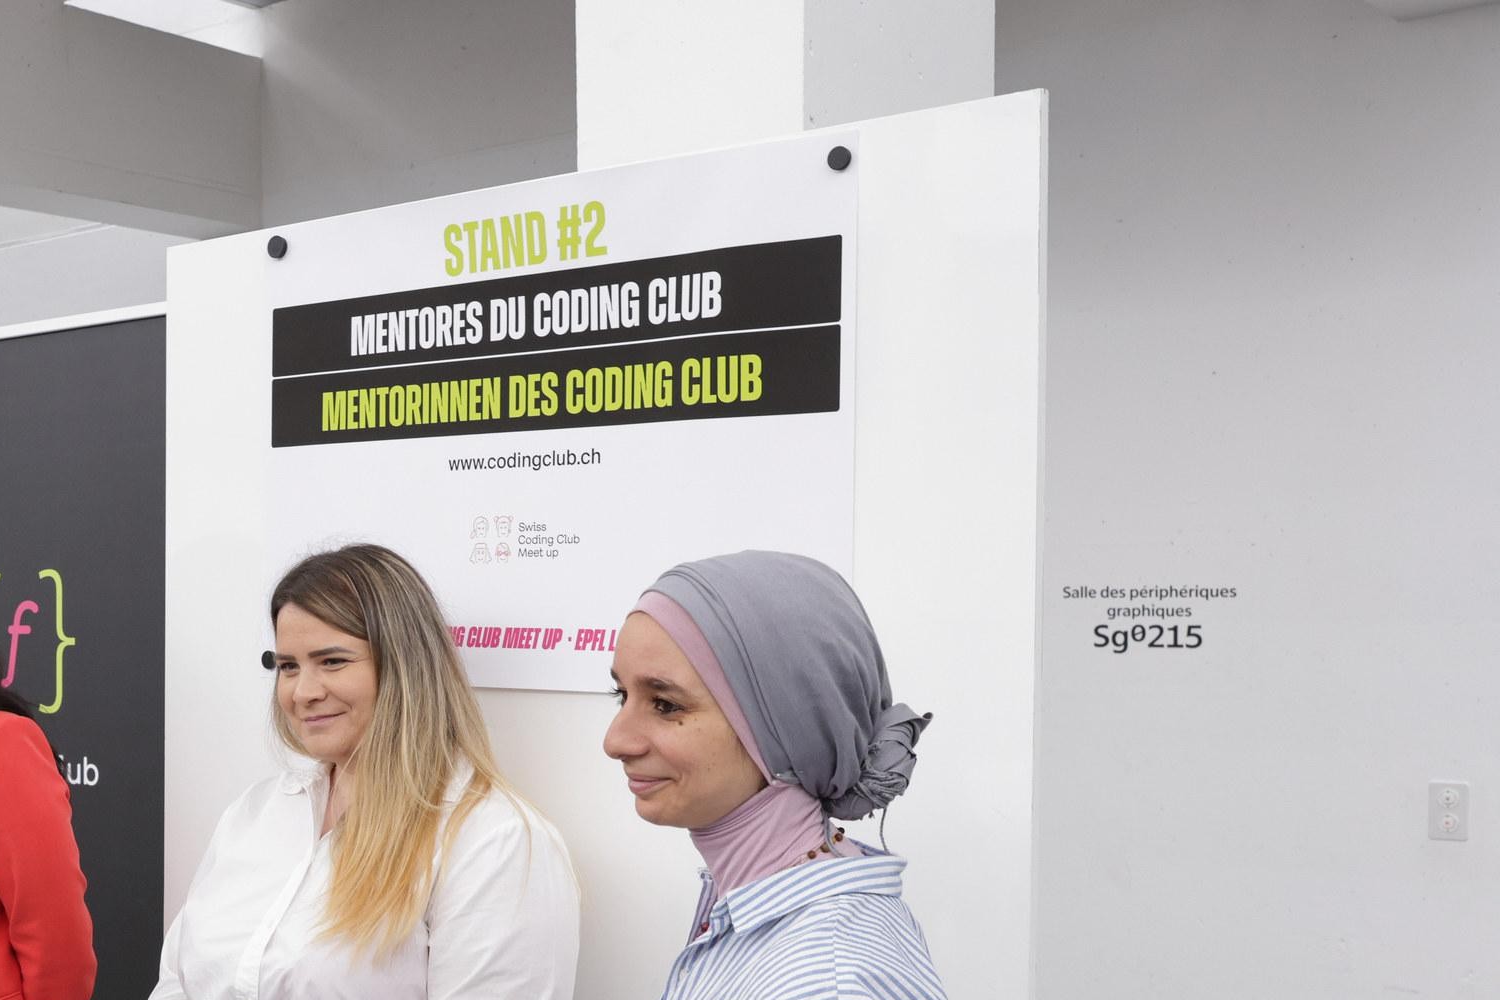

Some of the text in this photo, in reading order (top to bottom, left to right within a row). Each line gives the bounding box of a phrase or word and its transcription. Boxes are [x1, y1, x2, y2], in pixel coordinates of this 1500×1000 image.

[443, 200, 609, 278] STAND #2
[350, 270, 722, 357] MENTORES DU CODING CLUB
[321, 353, 763, 432] MENTORINNEN DES CODING CLUB
[448, 448, 601, 471] www.codingclub.ch
[517, 522, 547, 532] Swiss
[517, 534, 580, 546] Coding Club
[517, 548, 559, 559] Meet up
[1062, 584, 1237, 600] Salle des périphériques
[1106, 604, 1192, 620] graphiques
[466, 625, 501, 649] CLUB
[501, 627, 542, 650] MEET
[542, 628, 564, 650] UP
[574, 628, 606, 652] EPFL
